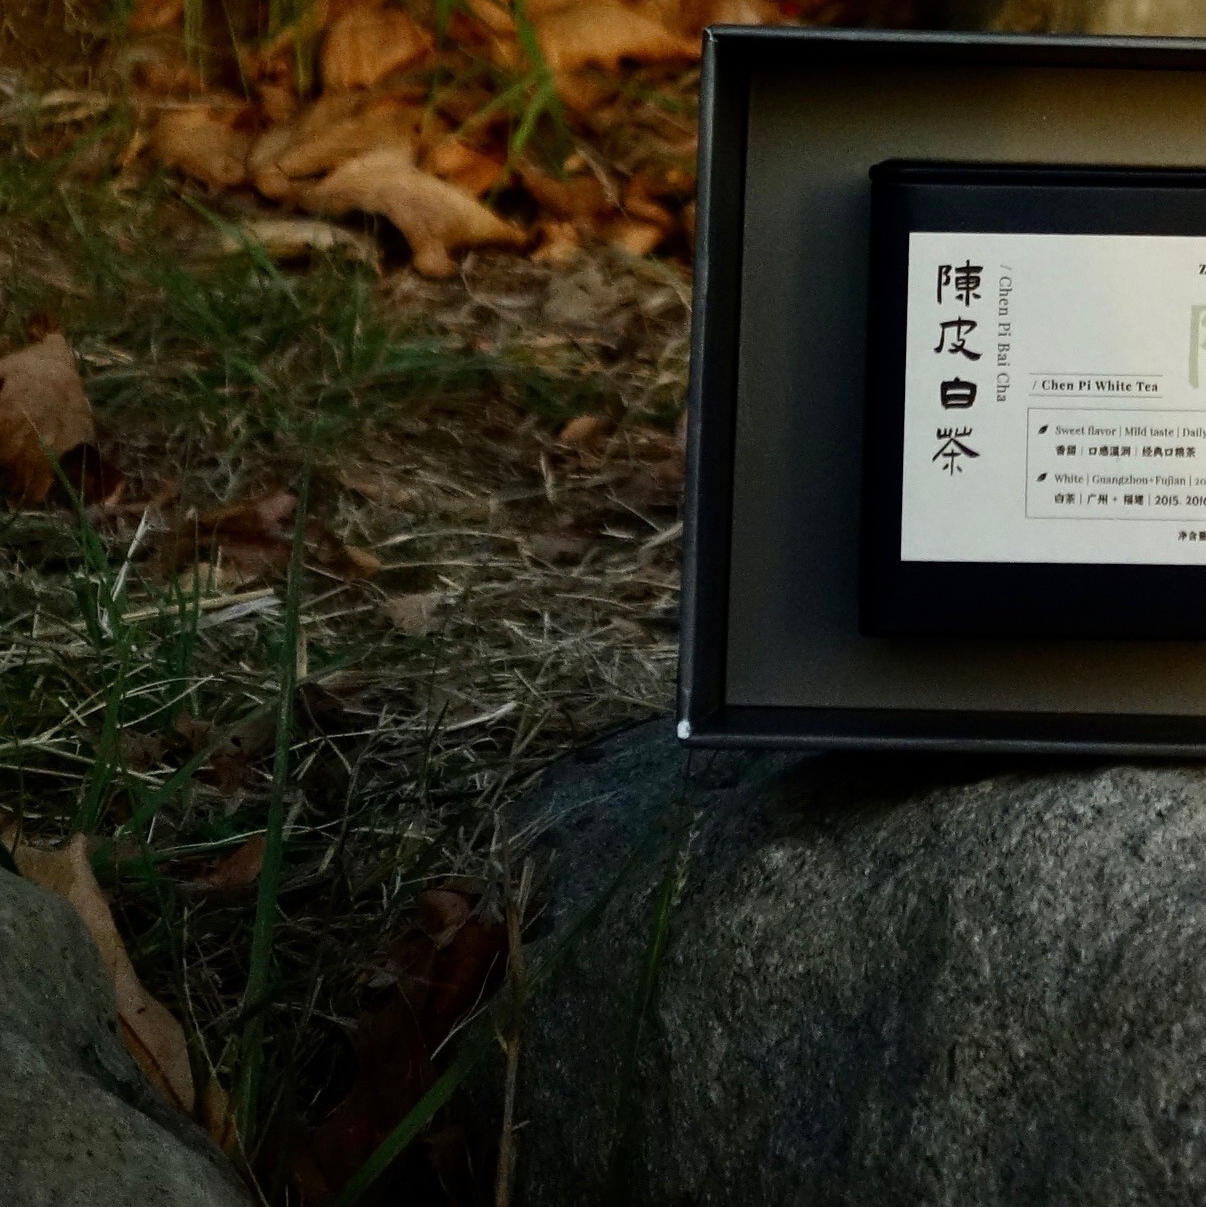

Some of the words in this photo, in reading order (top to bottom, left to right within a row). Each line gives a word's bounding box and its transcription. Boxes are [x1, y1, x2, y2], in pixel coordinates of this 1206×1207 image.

[998, 276, 1013, 316] Chen
[997, 322, 1012, 337] Pi
[996, 344, 1012, 367] Bai
[931, 259, 984, 476] 陳皮白茶
[996, 372, 1011, 403] Cha
[1041, 379, 1074, 391] Chen
[1079, 380, 1091, 391] Pi
[1095, 380, 1132, 392] White
[1136, 381, 1158, 392] Tea
[1055, 425, 1085, 436] Sweet
[1088, 425, 1117, 436] flavor
[1125, 426, 1147, 437] Mild
[1150, 427, 1174, 437] taste
[1054, 473, 1084, 484] White
[1054, 493, 1076, 504] 白茶
